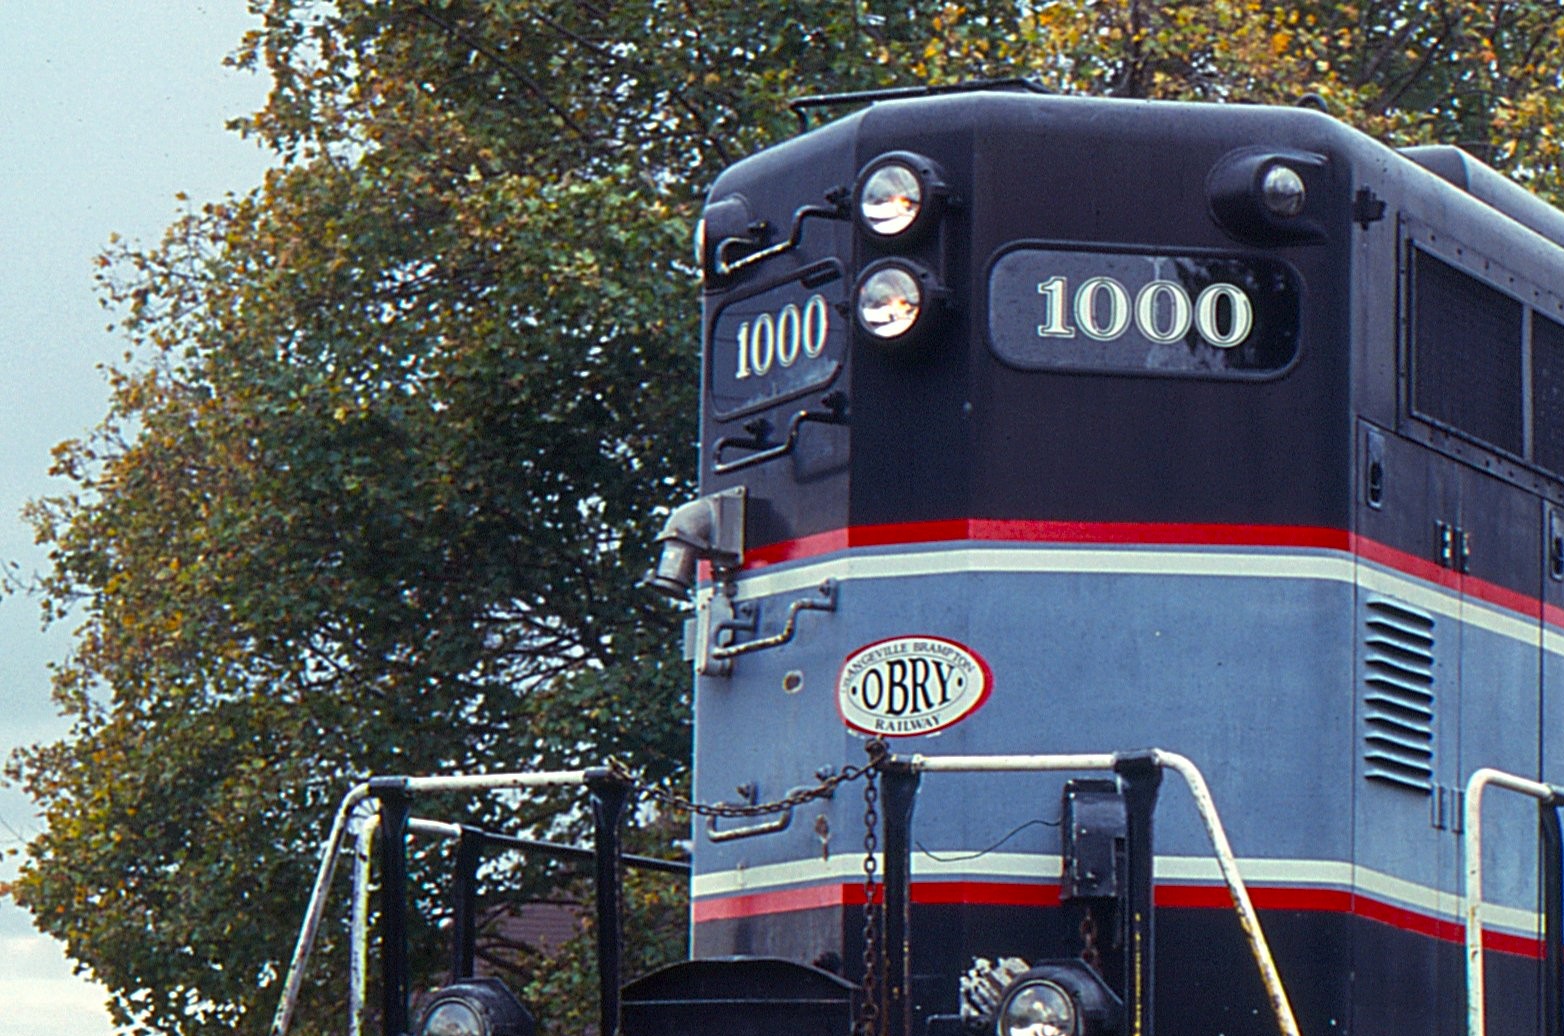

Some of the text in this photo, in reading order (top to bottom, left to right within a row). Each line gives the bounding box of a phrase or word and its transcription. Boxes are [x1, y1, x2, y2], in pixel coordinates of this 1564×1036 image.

[735, 294, 829, 380] 1000
[1037, 274, 1254, 349] 1000
[913, 641, 975, 673] BRAMPTON
[862, 658, 955, 715] OBRY
[874, 715, 942, 731] RAILWAY
